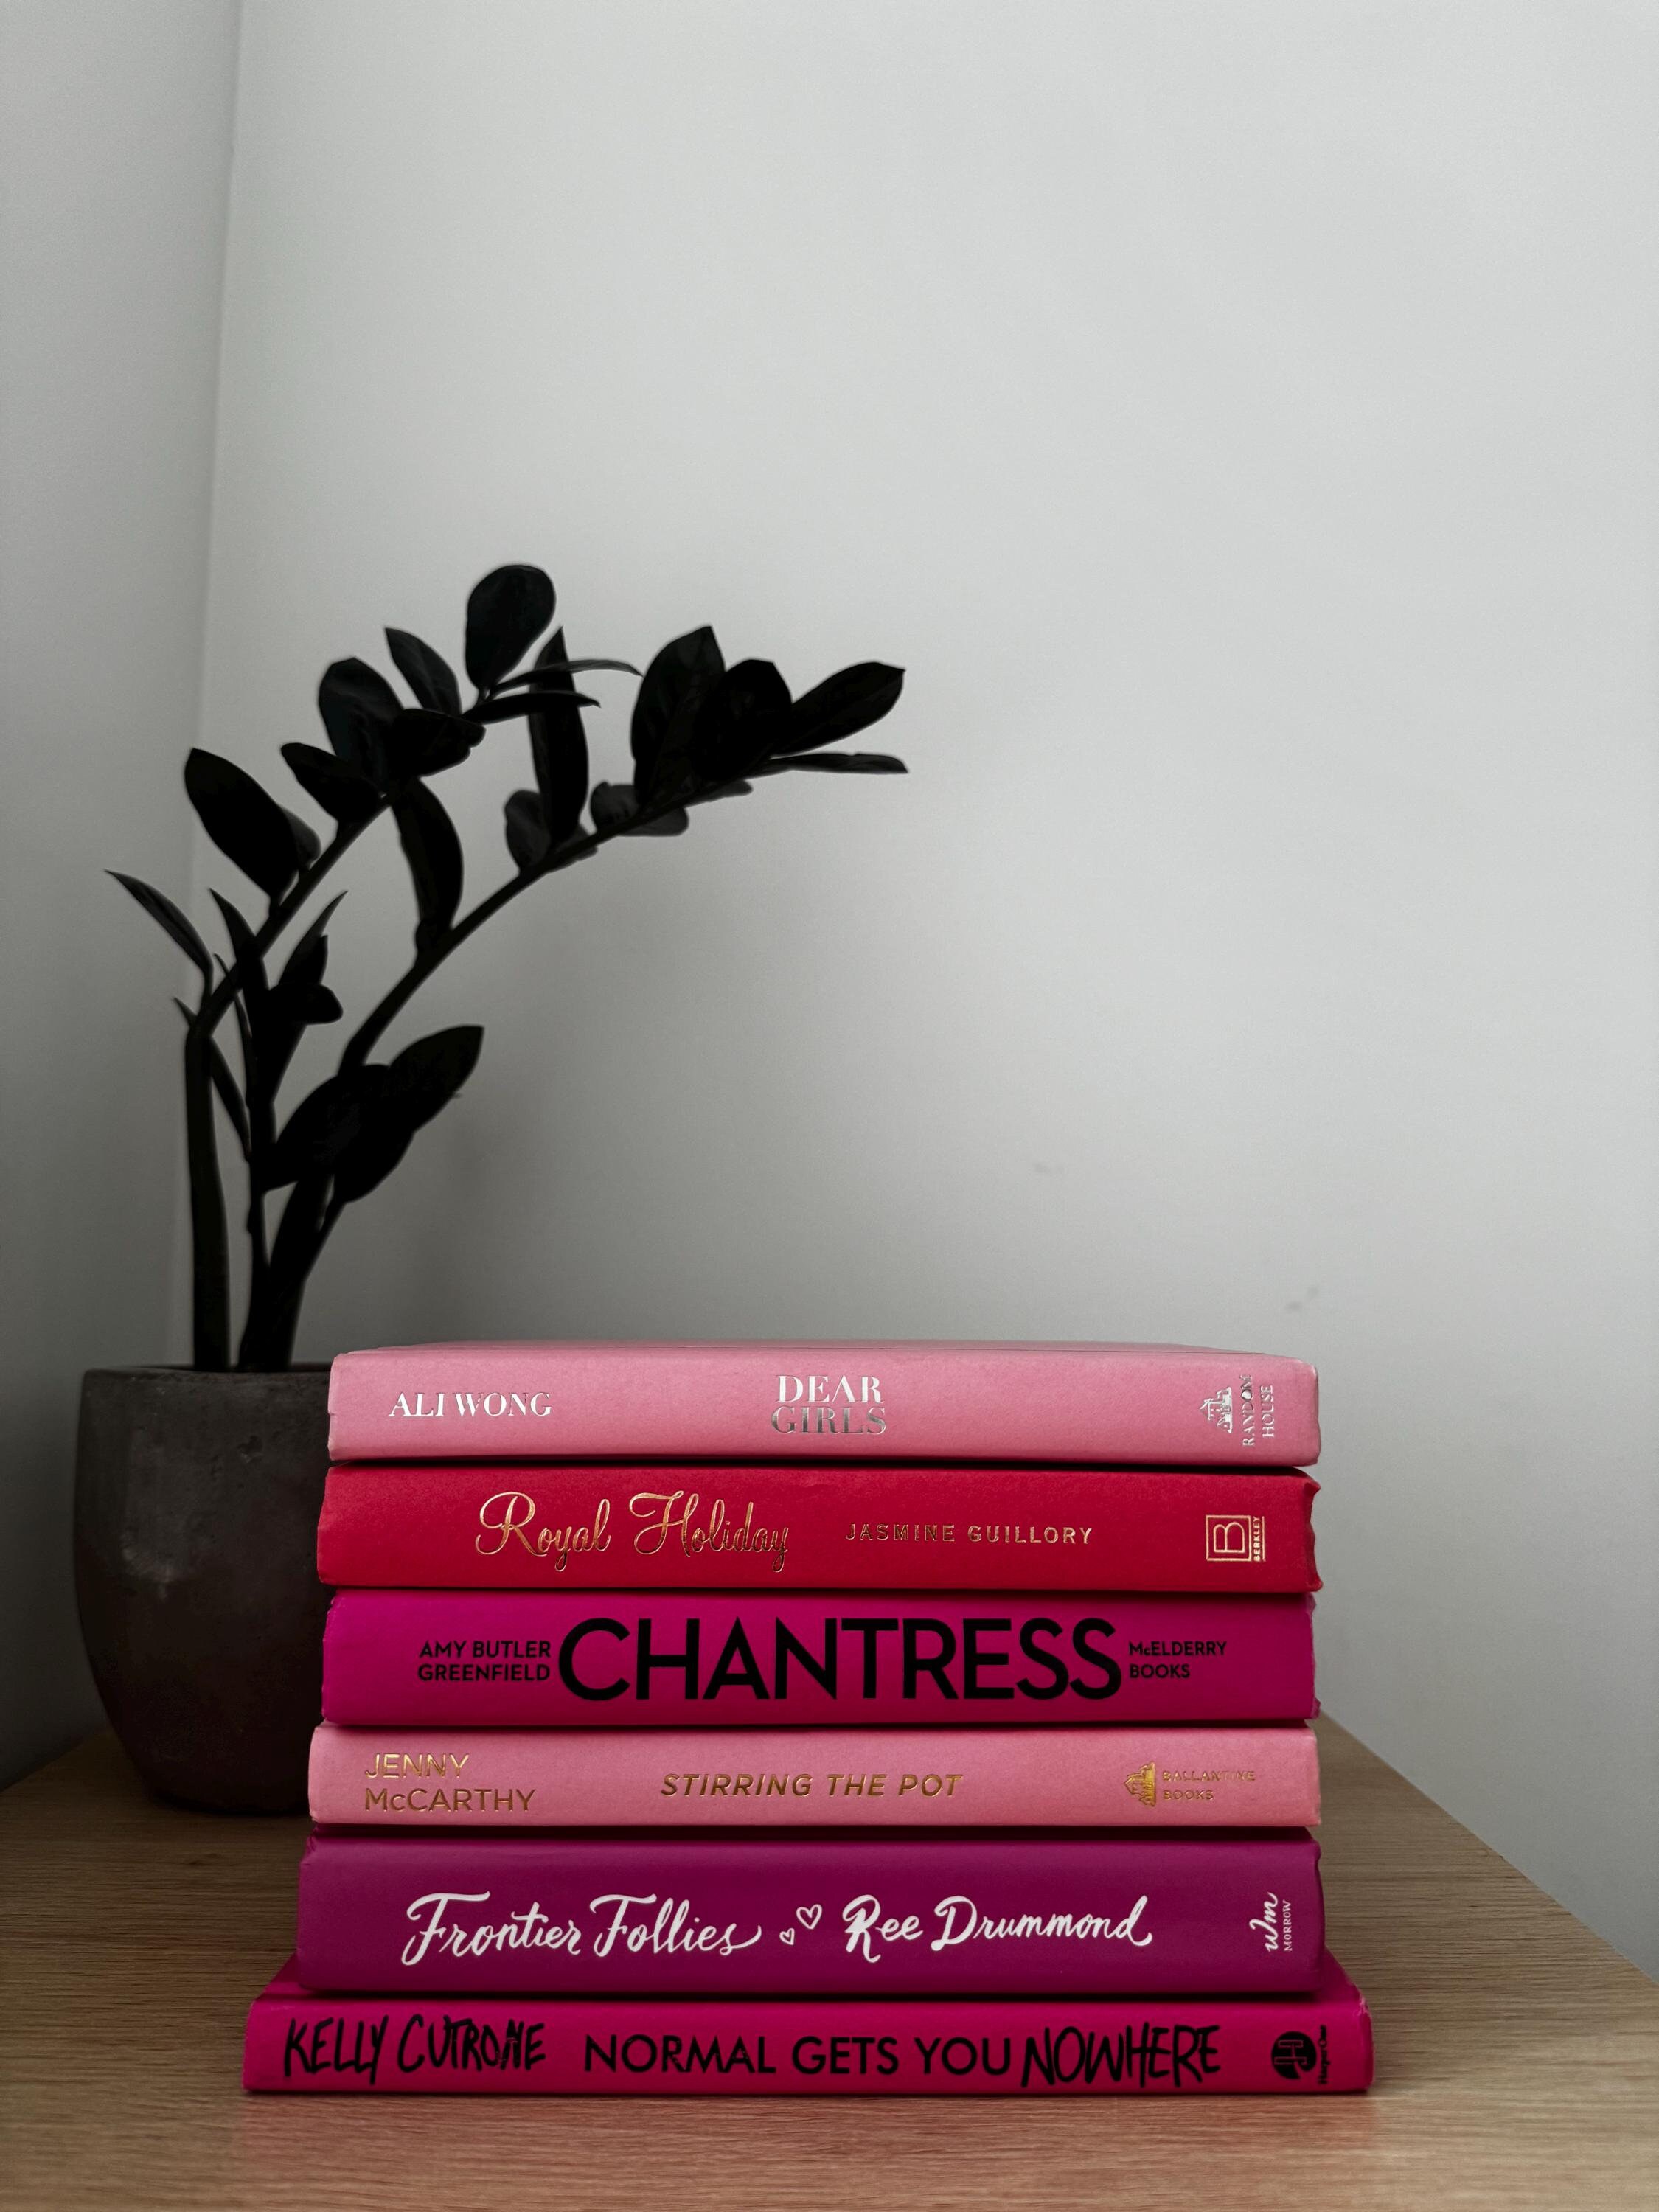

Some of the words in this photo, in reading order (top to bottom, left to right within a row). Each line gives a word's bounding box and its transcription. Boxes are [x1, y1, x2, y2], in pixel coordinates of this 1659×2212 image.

[776, 1374, 883, 1403] DEAR
[389, 1392, 445, 1417] ALI
[455, 1392, 552, 1417] WONG
[1241, 1374, 1254, 1447] RANDOM
[1261, 1385, 1275, 1438] HOUSE
[771, 1405, 886, 1435] GIRLS
[475, 1491, 611, 1572] Royal
[628, 1489, 789, 1573] Holiday
[845, 1523, 955, 1543] JASMINE
[967, 1524, 1093, 1545] GUILLORY
[1253, 1516, 1262, 1562] BERKLEY
[419, 1640, 465, 1658] AMY
[473, 1640, 551, 1658] BUTLER
[559, 1617, 1121, 1700] CHANTRESS
[1128, 1641, 1226, 1657] McELDERRY
[417, 1663, 550, 1682] GREENFIELD
[1129, 1663, 1191, 1680] BOOKS
[365, 1753, 470, 1778] JENNY
[1162, 1770, 1256, 1781] BALLANTINE
[661, 1773, 813, 1797] STIRRING
[827, 1774, 887, 1797] THE
[898, 1774, 963, 1797] POT
[1163, 1790, 1214, 1800] BOOKS
[365, 1788, 536, 1812] McCARTHY
[402, 1891, 582, 1965] Frontier
[590, 1893, 762, 1957] Follies
[842, 1894, 923, 1963] Ree
[931, 1895, 1152, 1951] Drummond
[1282, 1899, 1293, 1952] MORROW
[284, 2016, 388, 2085] KELLY
[398, 2014, 546, 2073] CUTRONE
[585, 2034, 776, 2074] NORMAL
[792, 2036, 899, 2075] GETS
[914, 2037, 1011, 2076] YOU
[1021, 2021, 1220, 2088] NOWHERE
